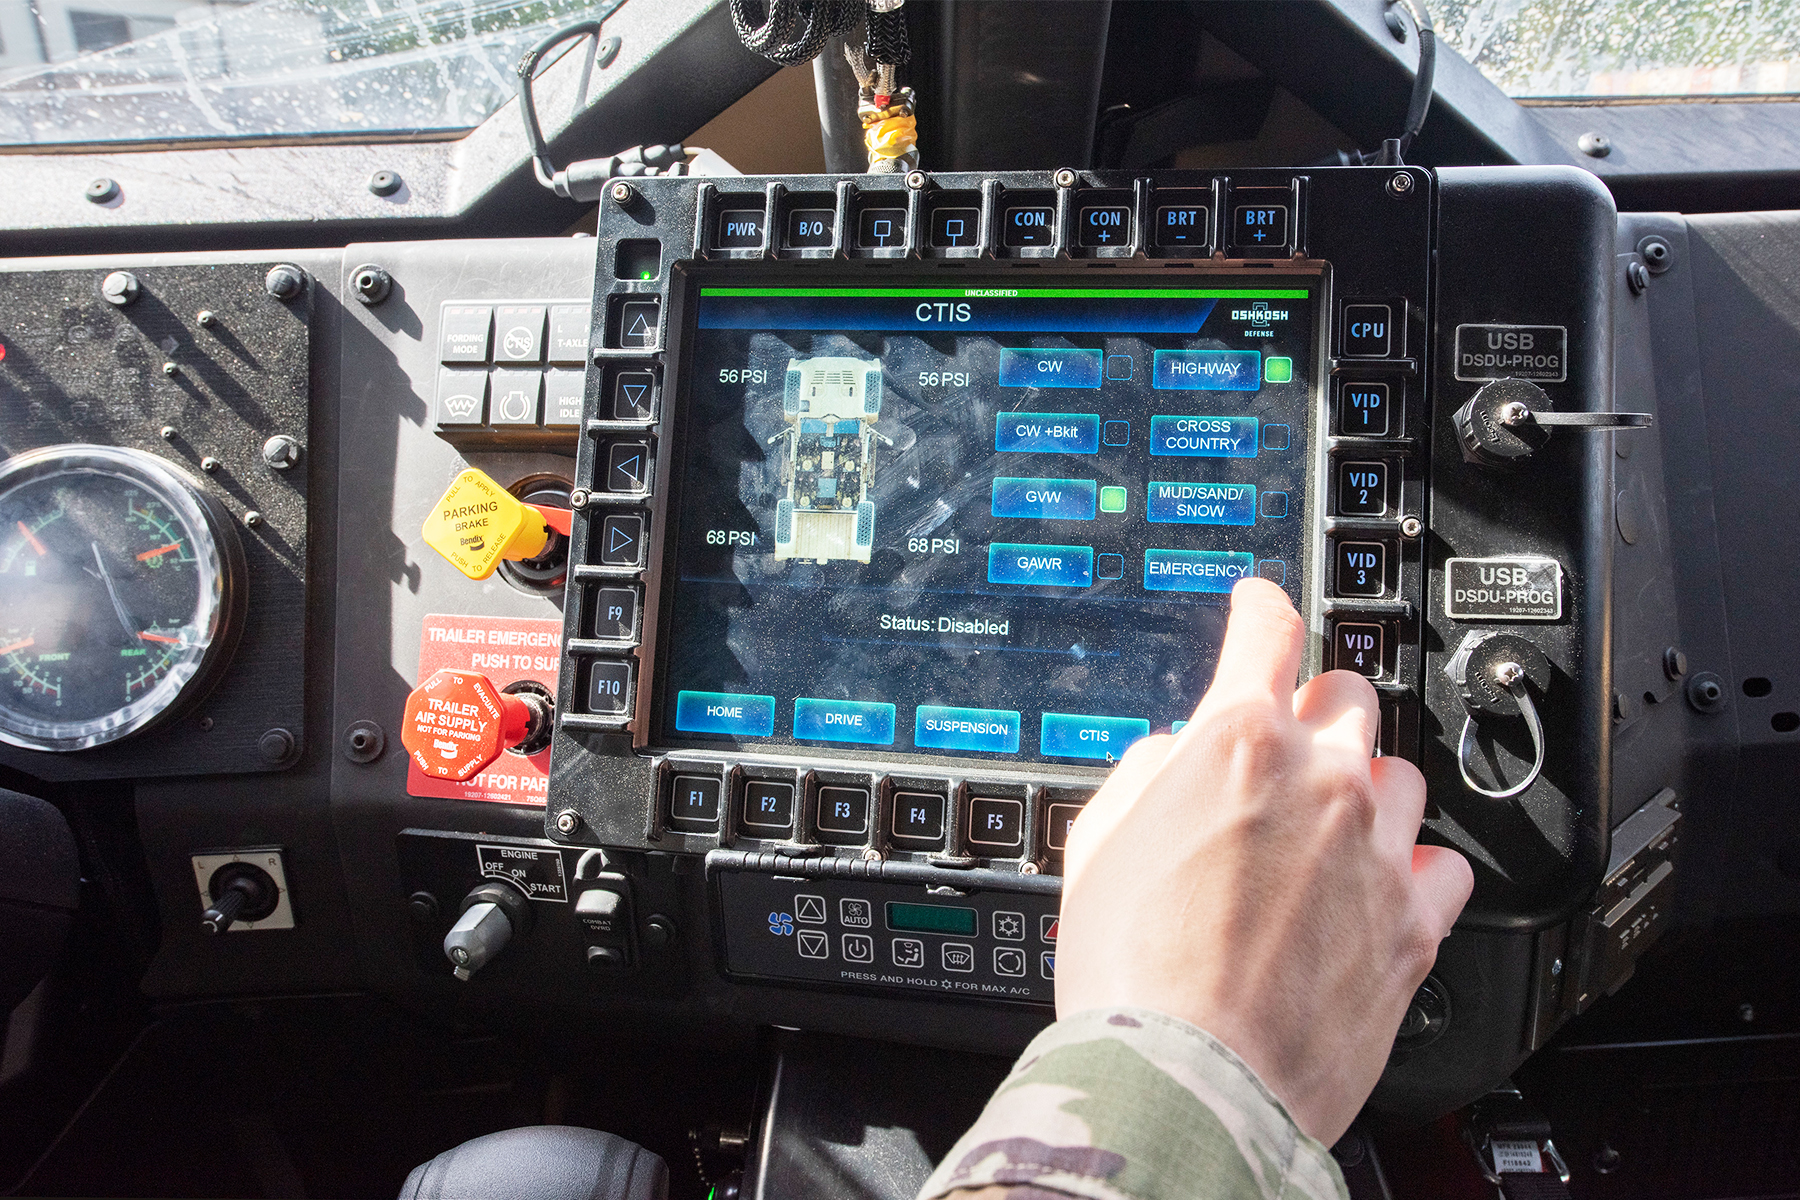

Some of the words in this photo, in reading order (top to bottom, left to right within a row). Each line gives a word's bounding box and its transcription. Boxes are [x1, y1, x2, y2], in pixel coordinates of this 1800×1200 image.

[1014, 212, 1045, 226] CON
[1090, 211, 1121, 226] CON
[1167, 211, 1197, 226] BRT
[1246, 210, 1276, 225] BRT
[727, 222, 756, 236] PWR
[799, 221, 823, 236] B/O
[1098, 230, 1111, 242] +
[1253, 229, 1266, 242] +
[965, 289, 1018, 297] UNCLASSIFIED
[915, 302, 971, 322] CTIS
[1231, 310, 1289, 321] OSHKOSH
[557, 324, 563, 333] L
[1351, 322, 1384, 338] CPU
[446, 333, 484, 343] FORDING
[557, 338, 589, 348] T-AXLE
[1487, 333, 1534, 350] USB
[452, 345, 478, 354] MODE
[1037, 360, 1063, 373] CW
[1462, 353, 1559, 368] DSDU-PROG
[1171, 362, 1242, 375] HIGHWAY
[719, 369, 738, 384] 56
[741, 370, 768, 384] PSI
[918, 372, 939, 387] 56
[942, 372, 970, 388] PSI
[558, 396, 582, 406] HIGH
[1351, 393, 1381, 408] VID
[559, 408, 580, 418] IDLE
[1363, 410, 1368, 425] 1
[1015, 425, 1041, 438] CW
[1045, 425, 1079, 438] +Bkit
[1176, 419, 1231, 433] CROSS
[1166, 437, 1241, 450] COUNTRY
[1349, 473, 1378, 488] VID
[446, 485, 461, 502] PULL
[463, 475, 474, 483] TO
[475, 480, 496, 498] APPLY
[1159, 486, 1244, 501] MUD/SAND/
[1025, 490, 1062, 504] GVW
[1359, 489, 1368, 504] 2
[443, 501, 498, 521] PARKING
[1176, 504, 1225, 517] SNOW
[455, 518, 489, 532] BRAKE
[460, 534, 484, 546] Bendix
[706, 530, 726, 545] 68
[728, 531, 755, 546] PSI
[450, 551, 469, 568] PUSH
[472, 564, 483, 573] TO
[482, 533, 507, 564] RELEASE
[908, 538, 929, 553] 68
[931, 539, 960, 554] PSI
[1017, 556, 1062, 570] GAWR
[1347, 553, 1377, 568] VID
[1150, 561, 1248, 577] EMERGENCY
[1480, 567, 1528, 585] USB
[1356, 570, 1366, 585] 3
[1455, 589, 1554, 604] DSDU-PROG
[608, 606, 623, 621] F9
[880, 614, 935, 632] Status:
[938, 616, 1009, 636] Disabled
[428, 627, 486, 645] TRAILER
[1345, 634, 1375, 649] VID
[39, 652, 71, 662] FRONT
[121, 648, 147, 657] REAR
[1354, 651, 1364, 667] 4
[472, 653, 510, 669] PUSH
[512, 655, 532, 670] TO
[598, 680, 620, 695] F10
[424, 677, 443, 693] PULL
[453, 676, 464, 685] TO
[473, 682, 500, 720] EVACUATE
[428, 698, 479, 718] TRAILER
[707, 705, 743, 718] HOME
[415, 710, 437, 725] AIR
[438, 714, 487, 733] SUPPLY
[825, 713, 863, 726] DRIVE
[926, 719, 1009, 735] SUSPENSION
[417, 724, 432, 733] NOT
[433, 727, 448, 736] FOR
[448, 730, 481, 742] PARKING
[1079, 729, 1109, 742] CTIS
[414, 750, 429, 771] PUSH
[438, 766, 448, 775] TO
[457, 753, 483, 777] SUPPLY
[488, 774, 517, 790] FOR
[689, 791, 703, 807] F1
[761, 796, 776, 812] F2
[835, 802, 850, 818] F3
[910, 808, 926, 824] F4
[987, 814, 1004, 830] F5
[268, 858, 277, 866] R
[501, 849, 538, 861] ENGINE
[485, 862, 504, 871] OFF
[511, 868, 526, 878] ON
[530, 883, 561, 893] START
[582, 918, 611, 926] COMBAT
[843, 915, 868, 926] AUTO
[840, 970, 877, 981] PRESS
[880, 975, 904, 984] AND
[907, 978, 938, 987] HOLD
[955, 982, 978, 991] FOR
[982, 984, 1007, 994] MAX
[1010, 987, 1031, 995] A/C
